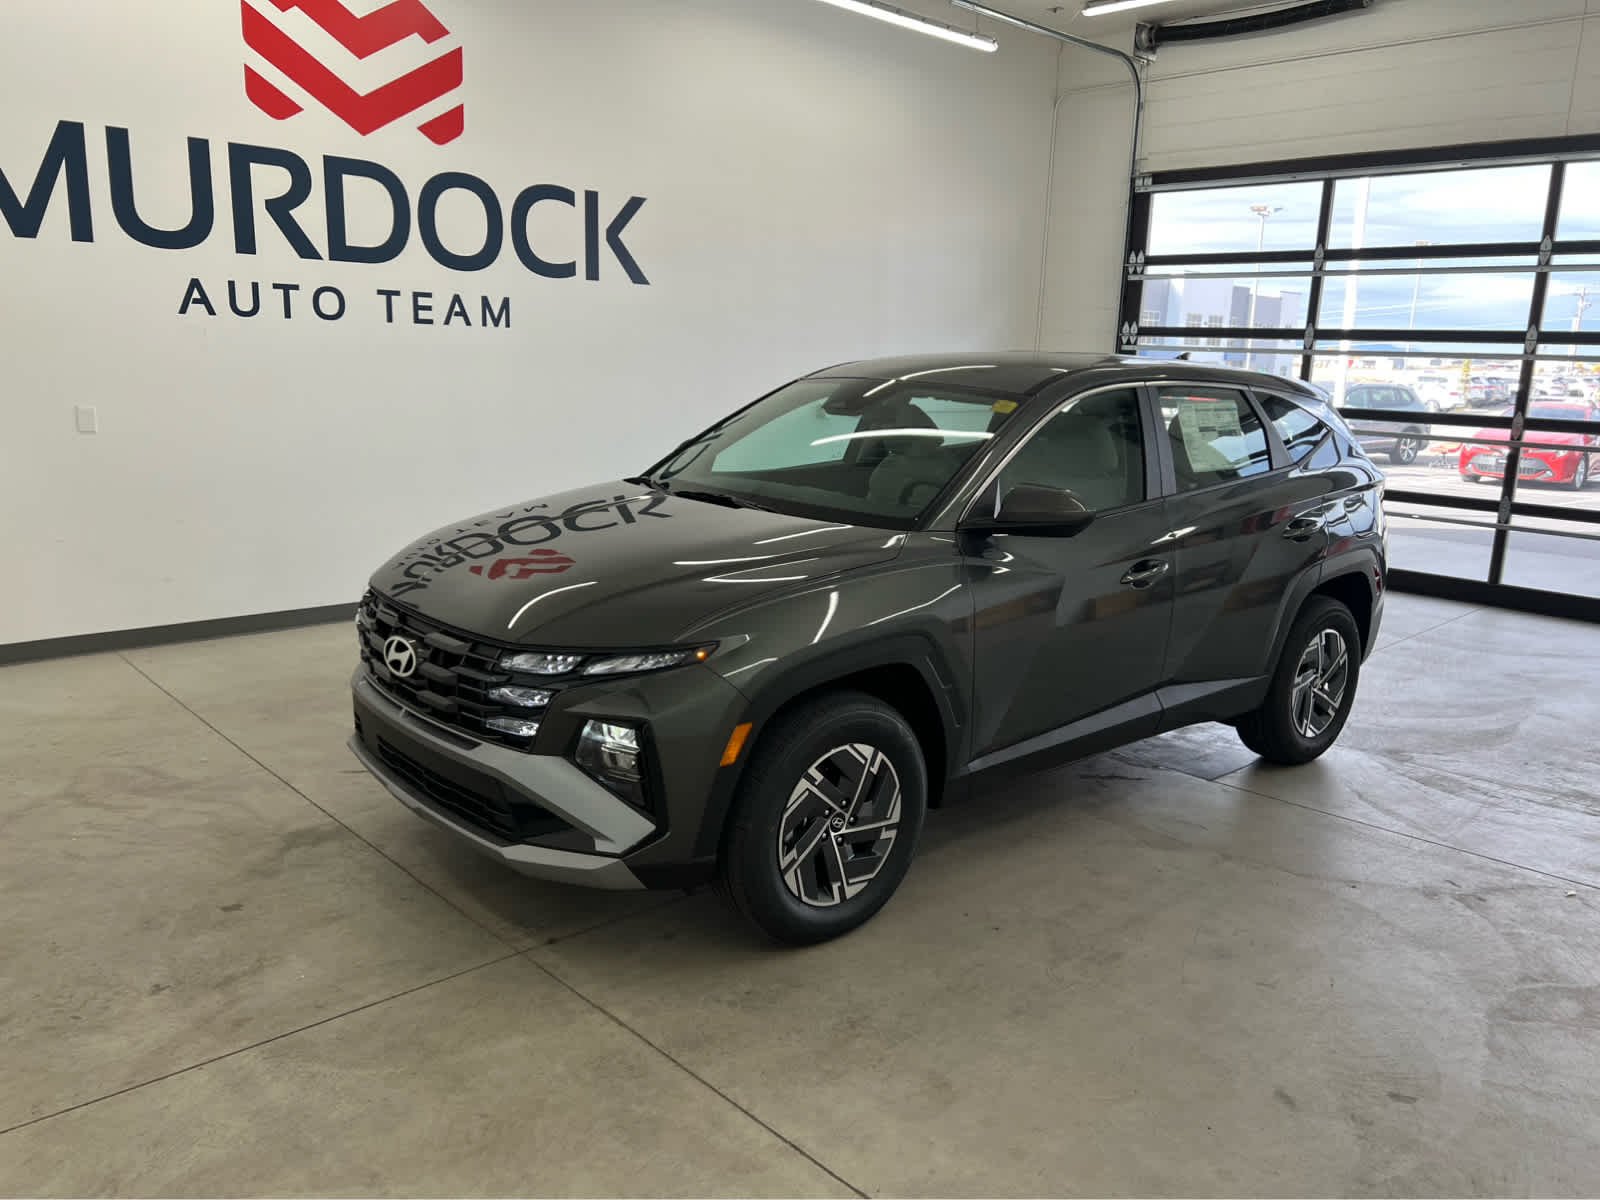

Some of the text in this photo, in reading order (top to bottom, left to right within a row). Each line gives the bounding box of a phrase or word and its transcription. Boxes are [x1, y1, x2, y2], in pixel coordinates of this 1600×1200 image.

[0, 120, 650, 285] MURDOCK
[179, 278, 511, 328] AUTO TEAM
